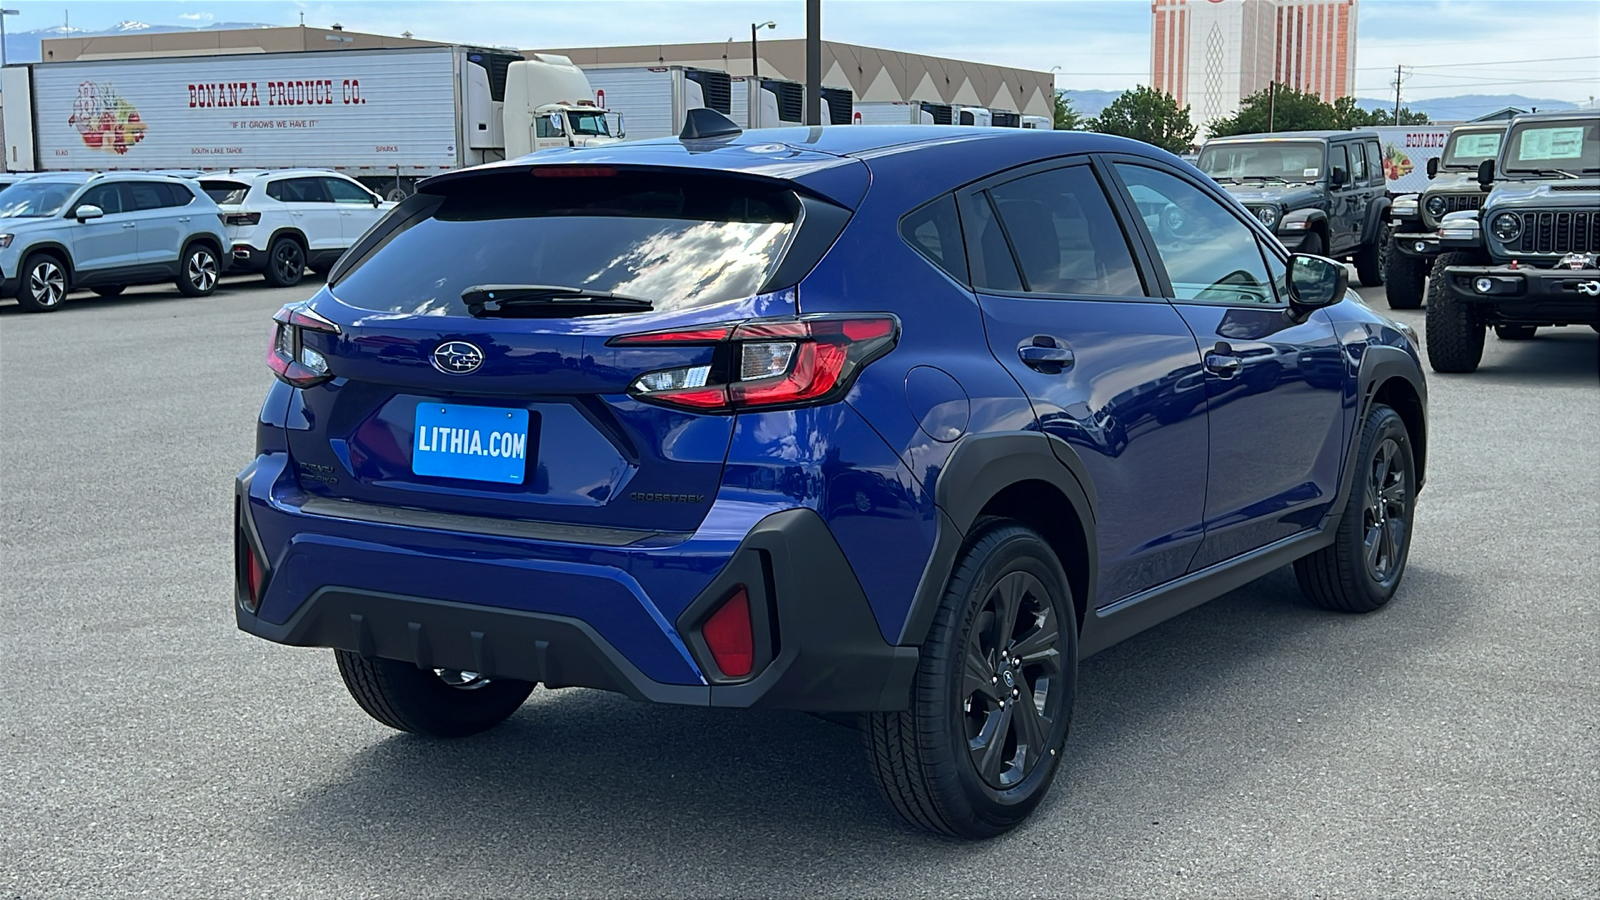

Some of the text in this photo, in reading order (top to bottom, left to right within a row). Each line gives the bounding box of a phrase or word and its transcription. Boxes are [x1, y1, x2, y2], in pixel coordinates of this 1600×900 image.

[188, 79, 366, 108] BONANZA PRODUCE CO.
[277, 120, 287, 128] WE
[289, 120, 307, 128] HAVE
[1406, 133, 1449, 148] BONANZ
[418, 425, 525, 459] LITHIA.COM
[630, 492, 704, 503] CROSSTREK
